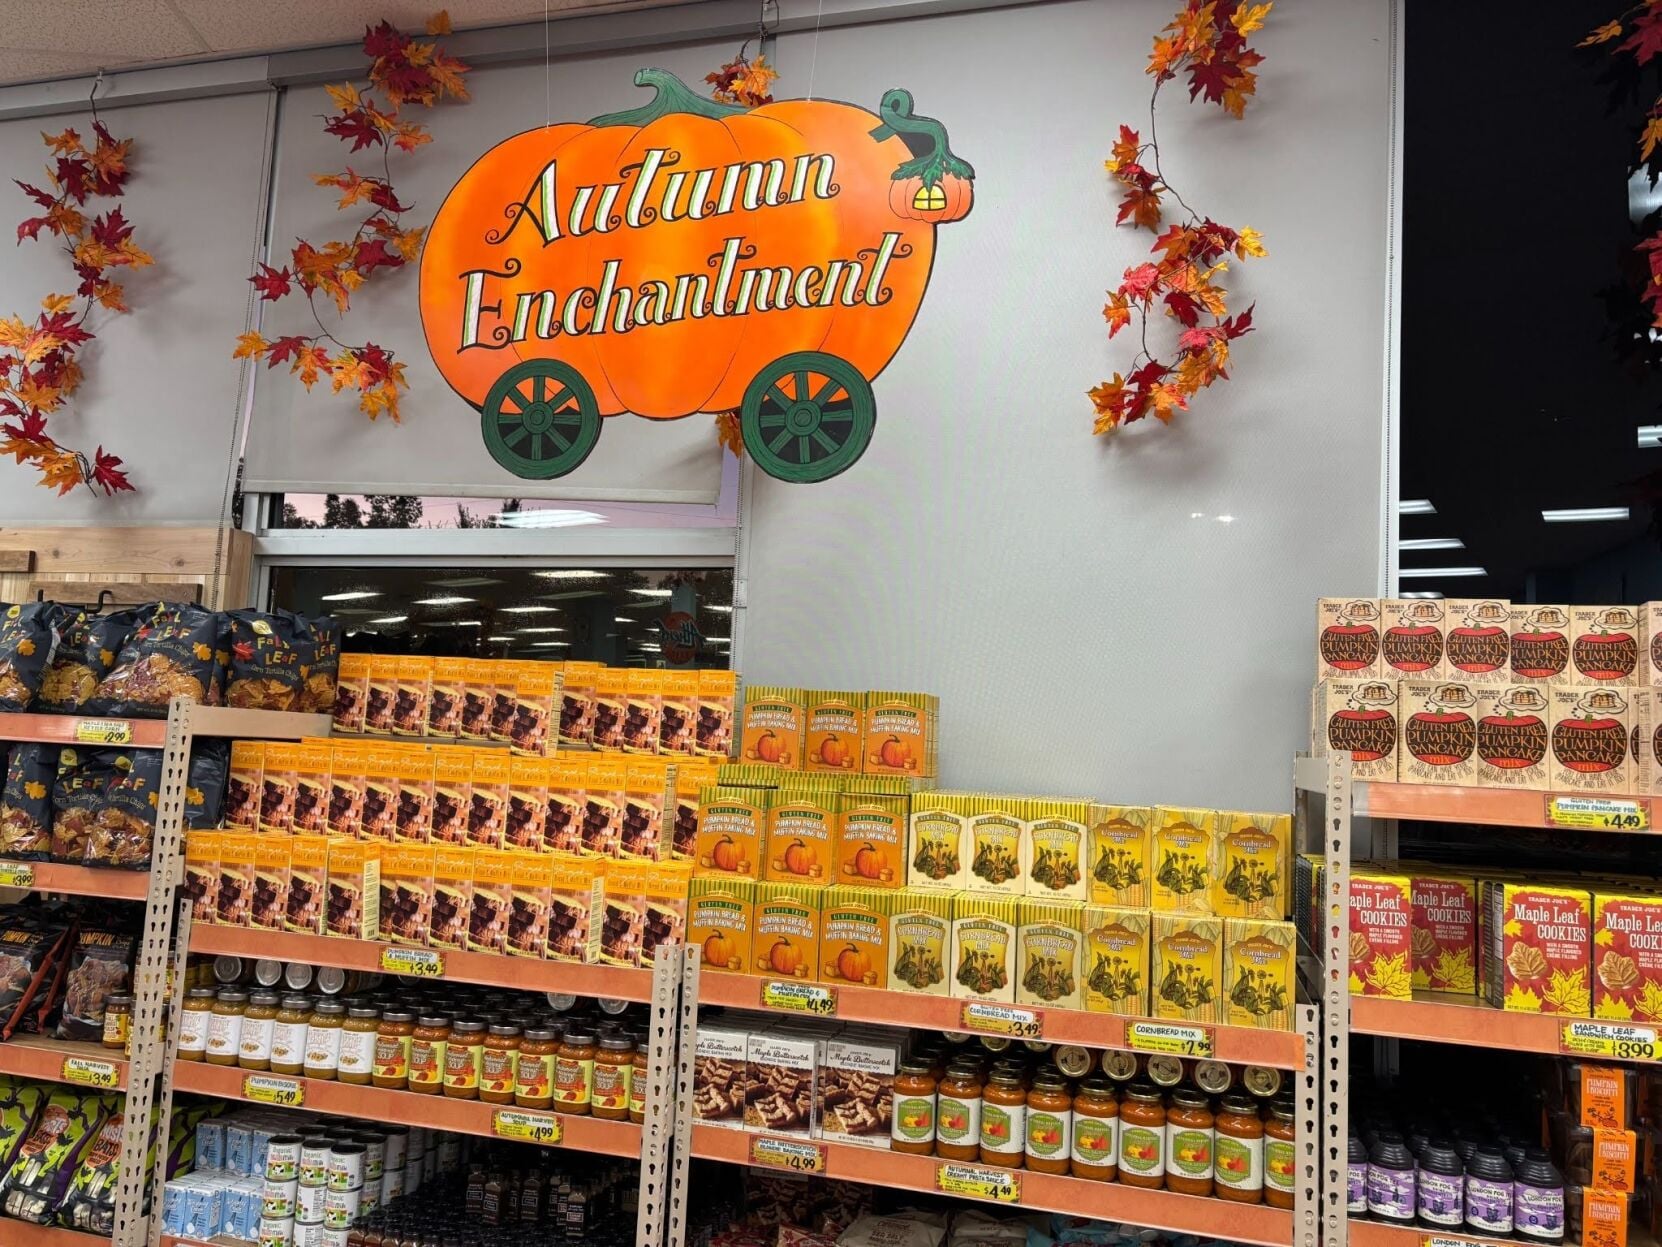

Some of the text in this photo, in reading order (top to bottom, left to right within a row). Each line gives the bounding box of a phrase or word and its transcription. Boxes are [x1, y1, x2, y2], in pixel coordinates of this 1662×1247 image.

[486, 148, 840, 247] Autumn
[457, 232, 912, 355] Enchantment
[1322, 630, 1379, 642] GLUTEN FREE
[1384, 632, 1443, 643] GLUTEN FREE
[1448, 632, 1509, 644] GLUTEN FREE
[1322, 641, 1379, 653] PUMPKIN
[1384, 642, 1443, 655] PUMPKIN
[1448, 643, 1509, 656] PUMPKIN
[1545, 638, 1568, 649] FREE
[1574, 639, 1637, 650] GLUTEN FREE
[1323, 651, 1376, 663] PANCAKE
[1385, 653, 1440, 665] PANCAKE
[1449, 654, 1506, 666] PANCAKE
[1575, 650, 1637, 663] PUMPKIN
[1576, 661, 1635, 673] PANCAKE
[1330, 716, 1396, 729] GLUTEN FREE
[1408, 719, 1475, 732] GLUTEN FREE
[1478, 722, 1547, 736] GLUTEN FREE
[1330, 727, 1395, 742] PUMPKIN
[1408, 731, 1475, 745] PUMPKIN
[1554, 725, 1627, 739] GLUTEN FREE
[1331, 740, 1393, 754] PANCAKE
[1478, 734, 1547, 749] PUMPKIN
[1554, 737, 1626, 753] PUMPKIN
[1351, 752, 1371, 760] mix
[1409, 744, 1472, 757] PANCAKE
[1478, 747, 1544, 761] PANCAKE
[1499, 759, 1521, 767] mix
[1556, 750, 1624, 765] PANCAKE
[1578, 763, 1600, 771] mix
[1557, 802, 1589, 810] PUMPKIN
[1591, 804, 1621, 812] PANCAKE
[1604, 814, 1640, 828] $4.49
[1101, 829, 1138, 839] Cornbread
[1165, 832, 1202, 843] Cornbread
[1232, 838, 1271, 849] Cornbread
[1350, 893, 1400, 911] aple Leaf
[1411, 890, 1465, 910] Maple Leaf
[694, 910, 719, 918] PUMPKIN
[722, 911, 739, 920] BREAD
[1361, 910, 1407, 927] COOKIES
[1428, 908, 1471, 923] COOKIES
[1514, 904, 1580, 925] Maple Leaf
[760, 916, 786, 925] PUMPKIN
[788, 917, 807, 927] BREAD
[827, 922, 854, 931] PUMPKIN
[856, 924, 875, 934] BREAD
[1606, 913, 1642, 934] Maple
[1537, 924, 1586, 942] COOKIES
[1097, 935, 1135, 946] Cornbread
[1168, 942, 1207, 953] Cornbread
[1240, 948, 1280, 958] Cornbread
[807, 998, 833, 1013] $4.49
[970, 1007, 1010, 1018] CORNBREAD
[1136, 1026, 1196, 1038] CORNBREAD MIX
[1574, 1024, 1636, 1035] MAPLE LEAF
[1575, 1030, 1614, 1040] SANDWICH
[1181, 1040, 1212, 1056] $2.99
[1612, 1041, 1654, 1059] $3.99
[786, 1156, 816, 1170] $4.99
